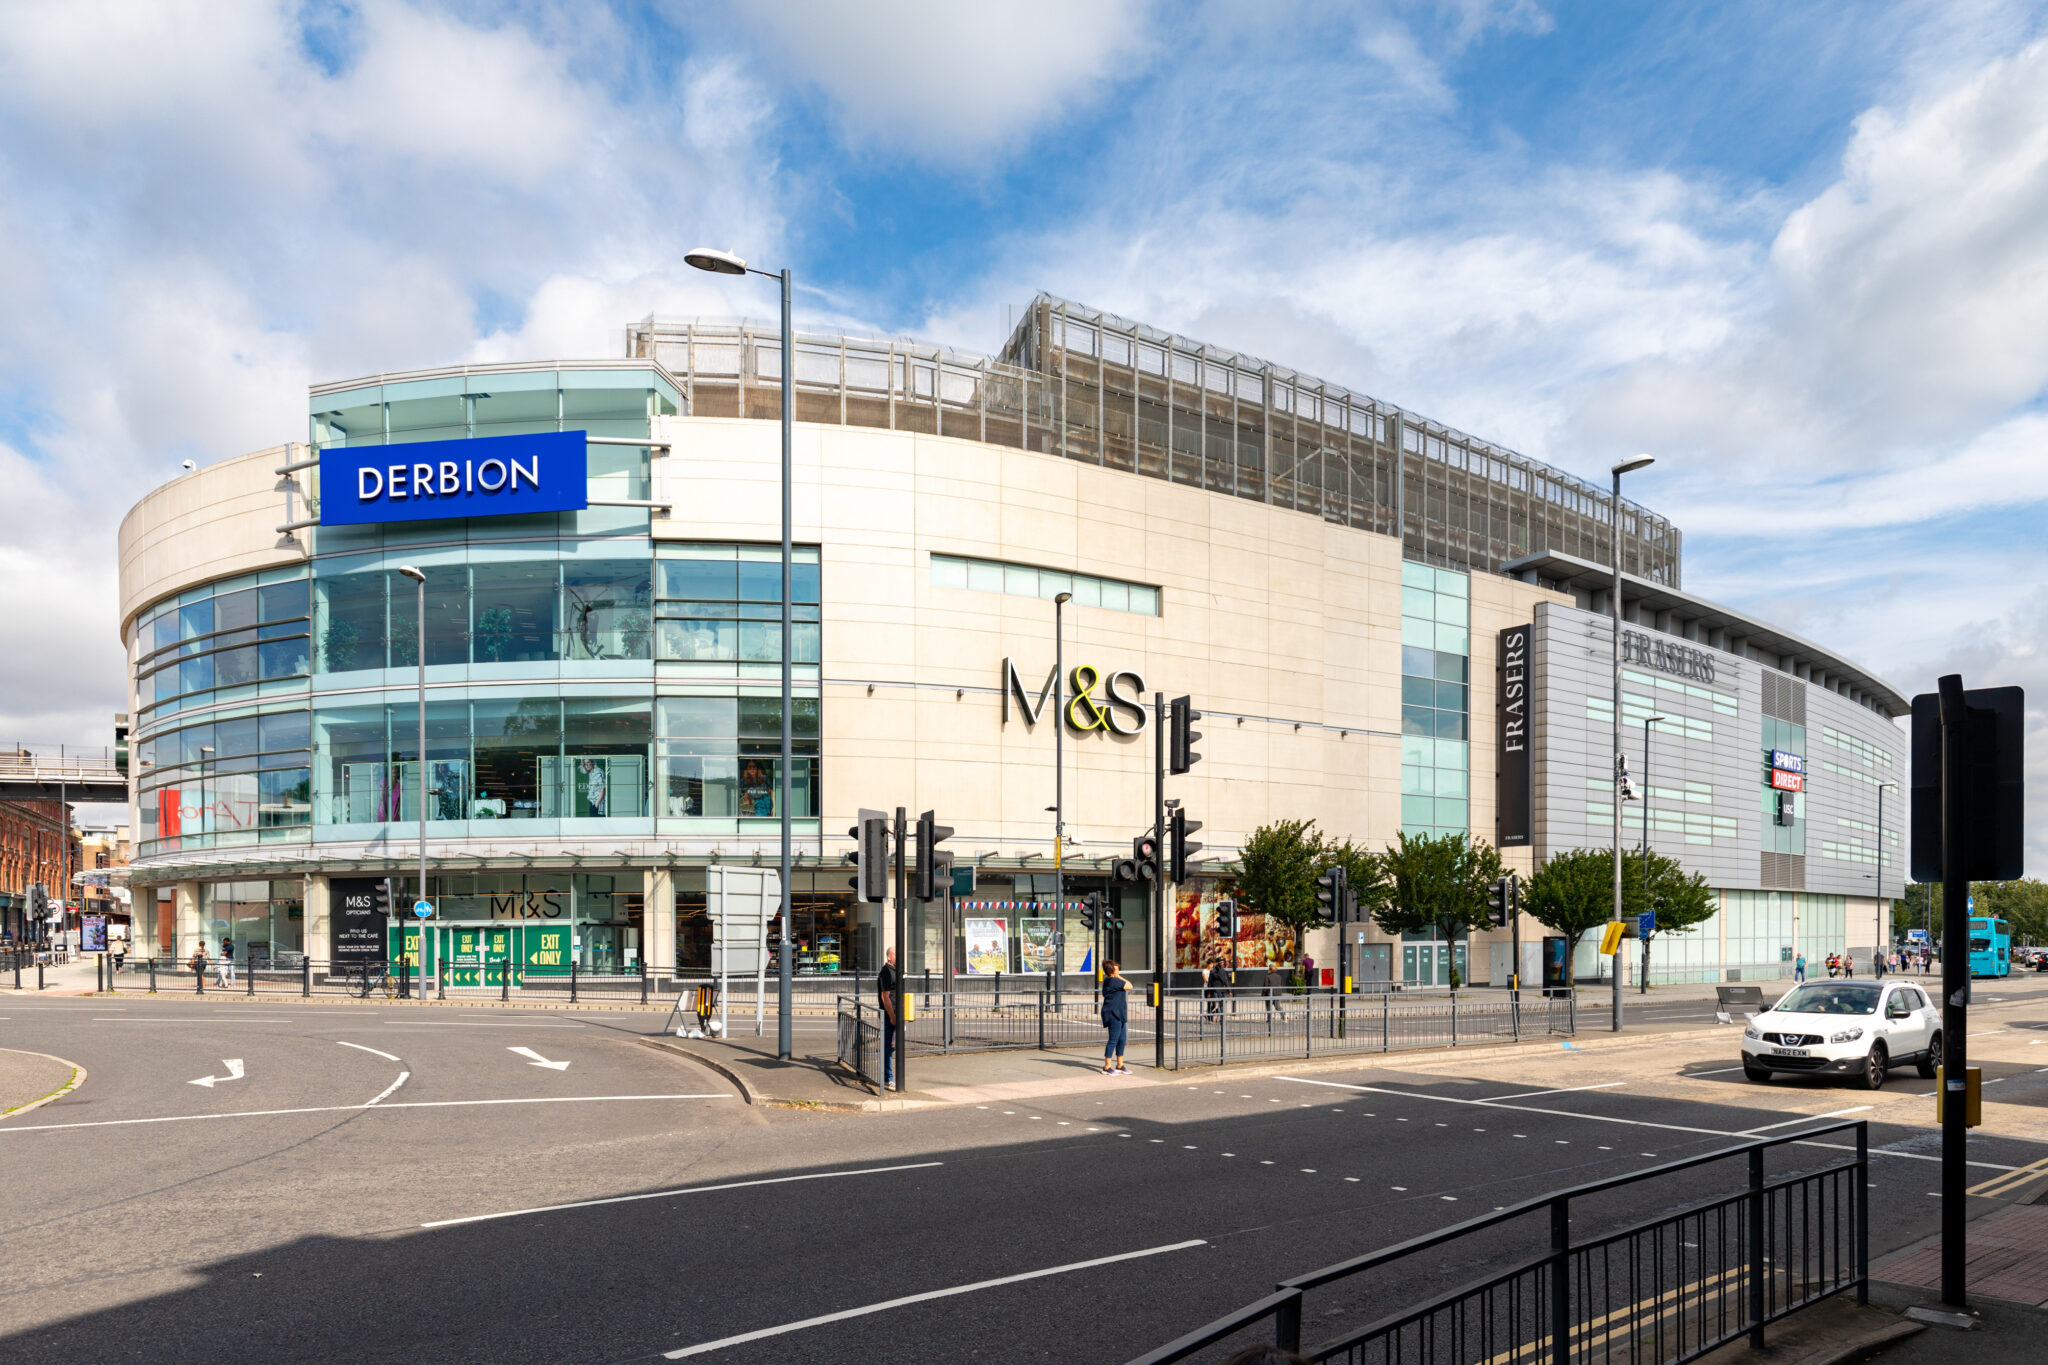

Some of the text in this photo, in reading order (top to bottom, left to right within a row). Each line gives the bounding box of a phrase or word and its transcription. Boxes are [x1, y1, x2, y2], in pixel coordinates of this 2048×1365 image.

[359, 455, 539, 499] DERBION
[1624, 629, 1716, 684] FRASERS
[1002, 656, 1147, 735] M&S
[1505, 632, 1524, 752] FRASERS
[1775, 752, 1802, 771] SPORTS
[1775, 772, 1801, 790] DIRECT
[1783, 804, 1794, 815] USC
[346, 896, 371, 908] M&S
[490, 889, 562, 919] M&S
[462, 935, 472, 944] EXIT
[494, 935, 504, 944] EXIT
[541, 934, 560, 950] EXIT
[461, 944, 473, 953] ONLY
[493, 944, 505, 953] ONLY
[540, 950, 562, 966] ONLY
[1773, 1048, 1807, 1057] NA62 EXM
